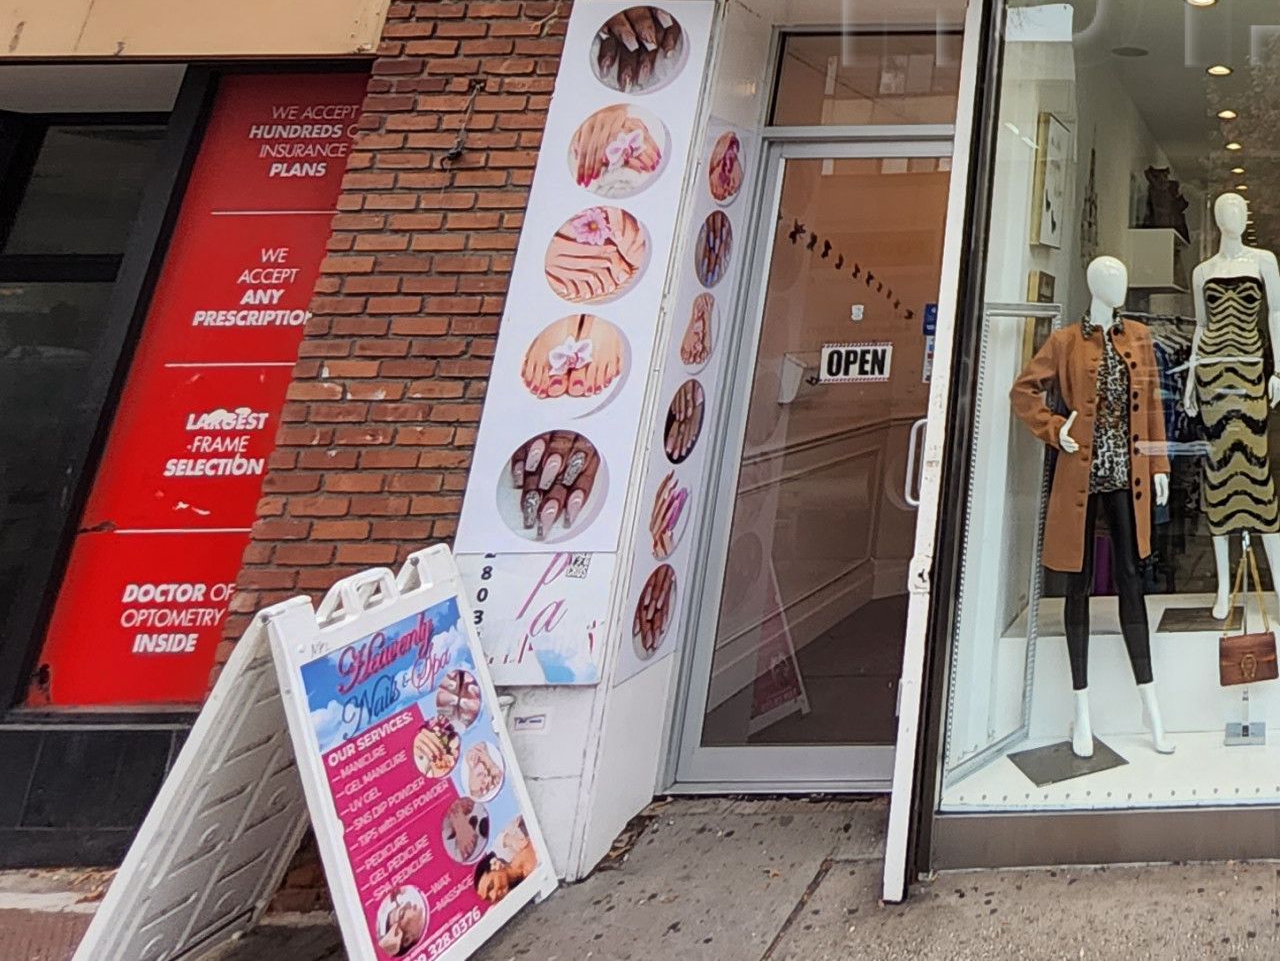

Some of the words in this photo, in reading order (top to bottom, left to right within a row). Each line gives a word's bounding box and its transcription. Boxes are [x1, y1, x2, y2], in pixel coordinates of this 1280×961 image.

[272, 105, 299, 119] WE
[299, 104, 360, 119] ACCEPT
[249, 123, 343, 139] HUNDREDS
[259, 143, 349, 158] INSURANCE
[269, 162, 328, 178] PLANS
[261, 247, 290, 263] WE
[237, 268, 300, 284] ACCEPT
[240, 289, 285, 305] ANY
[826, 349, 887, 378] OPEN
[191, 435, 251, 453] FRAME
[163, 458, 265, 477] SELECTION
[121, 583, 207, 603] DOCTOR
[209, 583, 237, 602] OF
[120, 608, 227, 628] OPTOMETRY
[132, 633, 199, 653] INSIDE
[338, 612, 434, 696] Heavenly
[342, 674, 401, 740] Nails
[412, 642, 450, 694] Spa
[328, 742, 357, 767] OUR
[356, 711, 414, 752] SERVICES:
